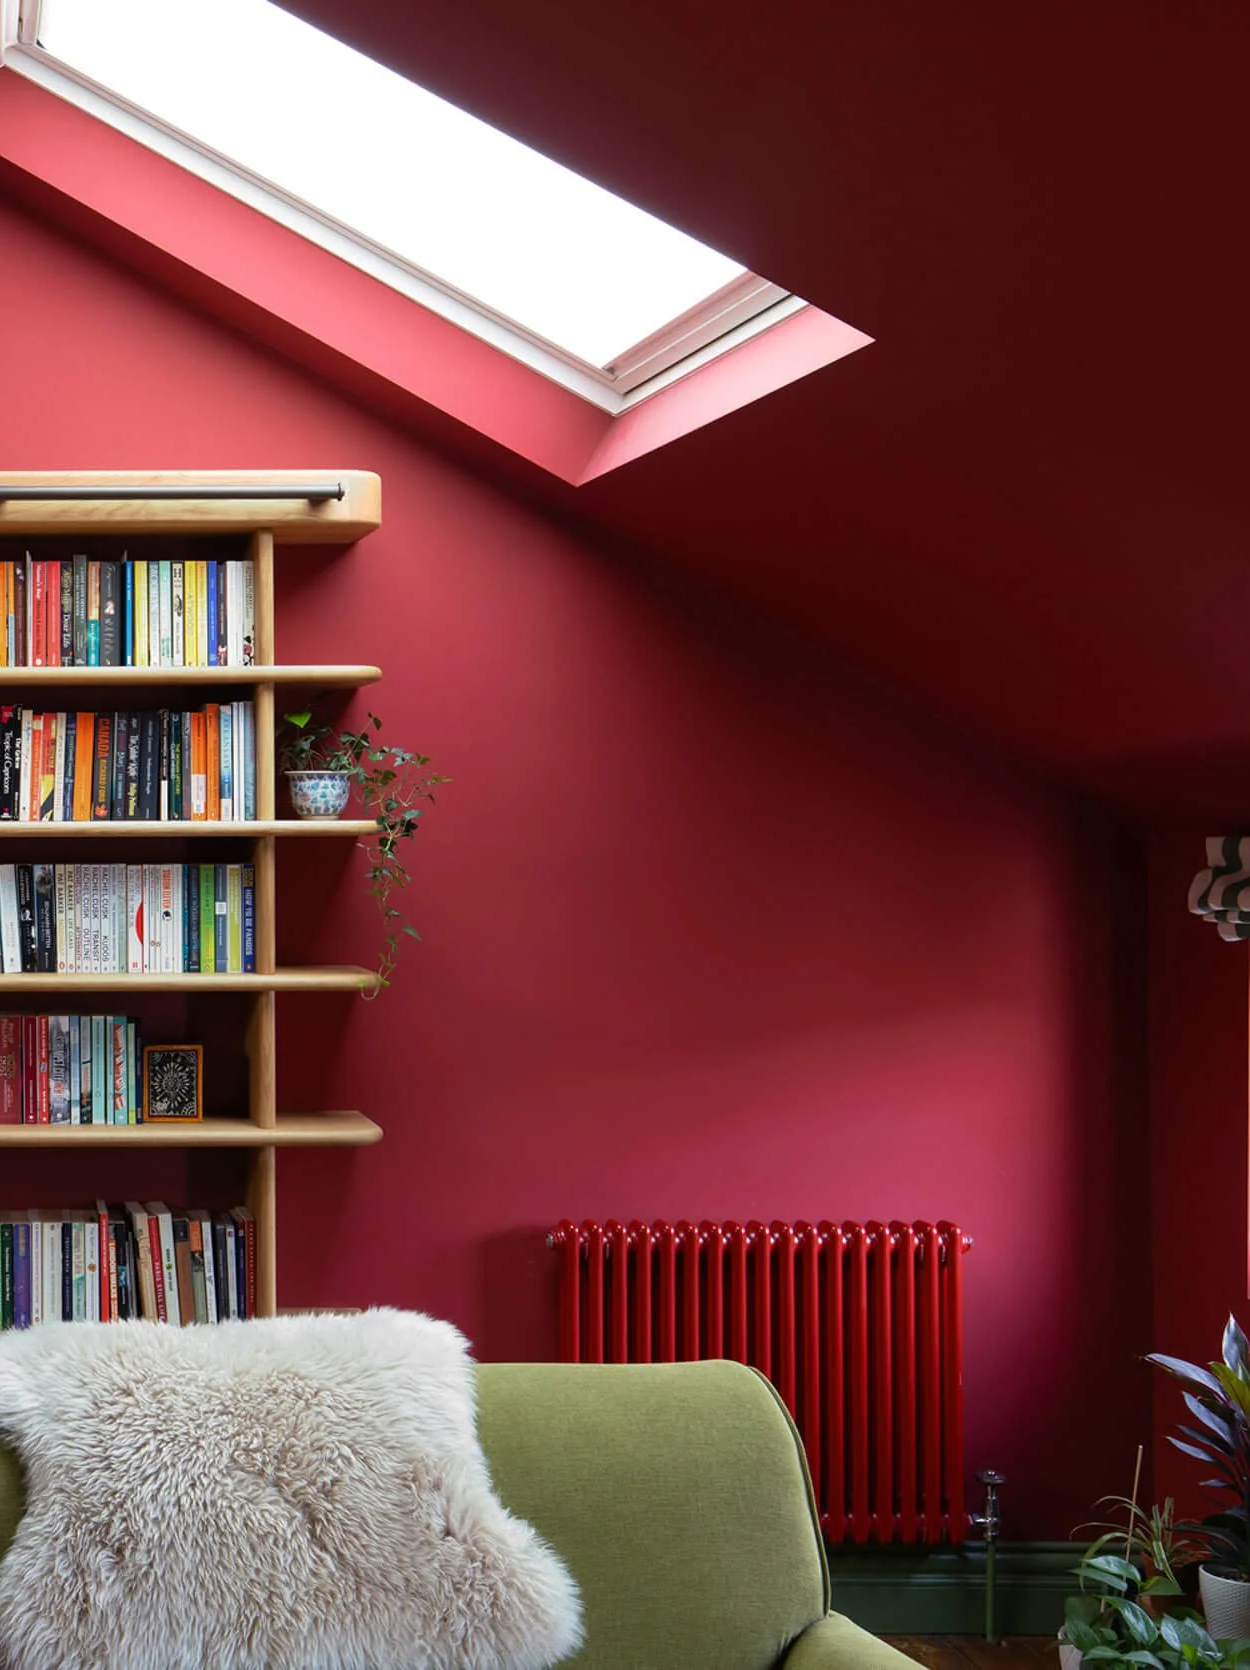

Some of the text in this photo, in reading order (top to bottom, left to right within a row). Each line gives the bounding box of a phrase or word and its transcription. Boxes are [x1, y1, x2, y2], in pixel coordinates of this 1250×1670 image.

[63, 614, 71, 631] Dear
[63, 632, 71, 649] Life
[3, 730, 13, 753] Tropic
[97, 718, 111, 758] CANADA
[3, 762, 13, 795] Capricorn
[245, 889, 253, 906] HOW
[109, 1243, 117, 1273] LONDON
[154, 1262, 162, 1281] PARIS
[156, 1283, 164, 1303] STILL
